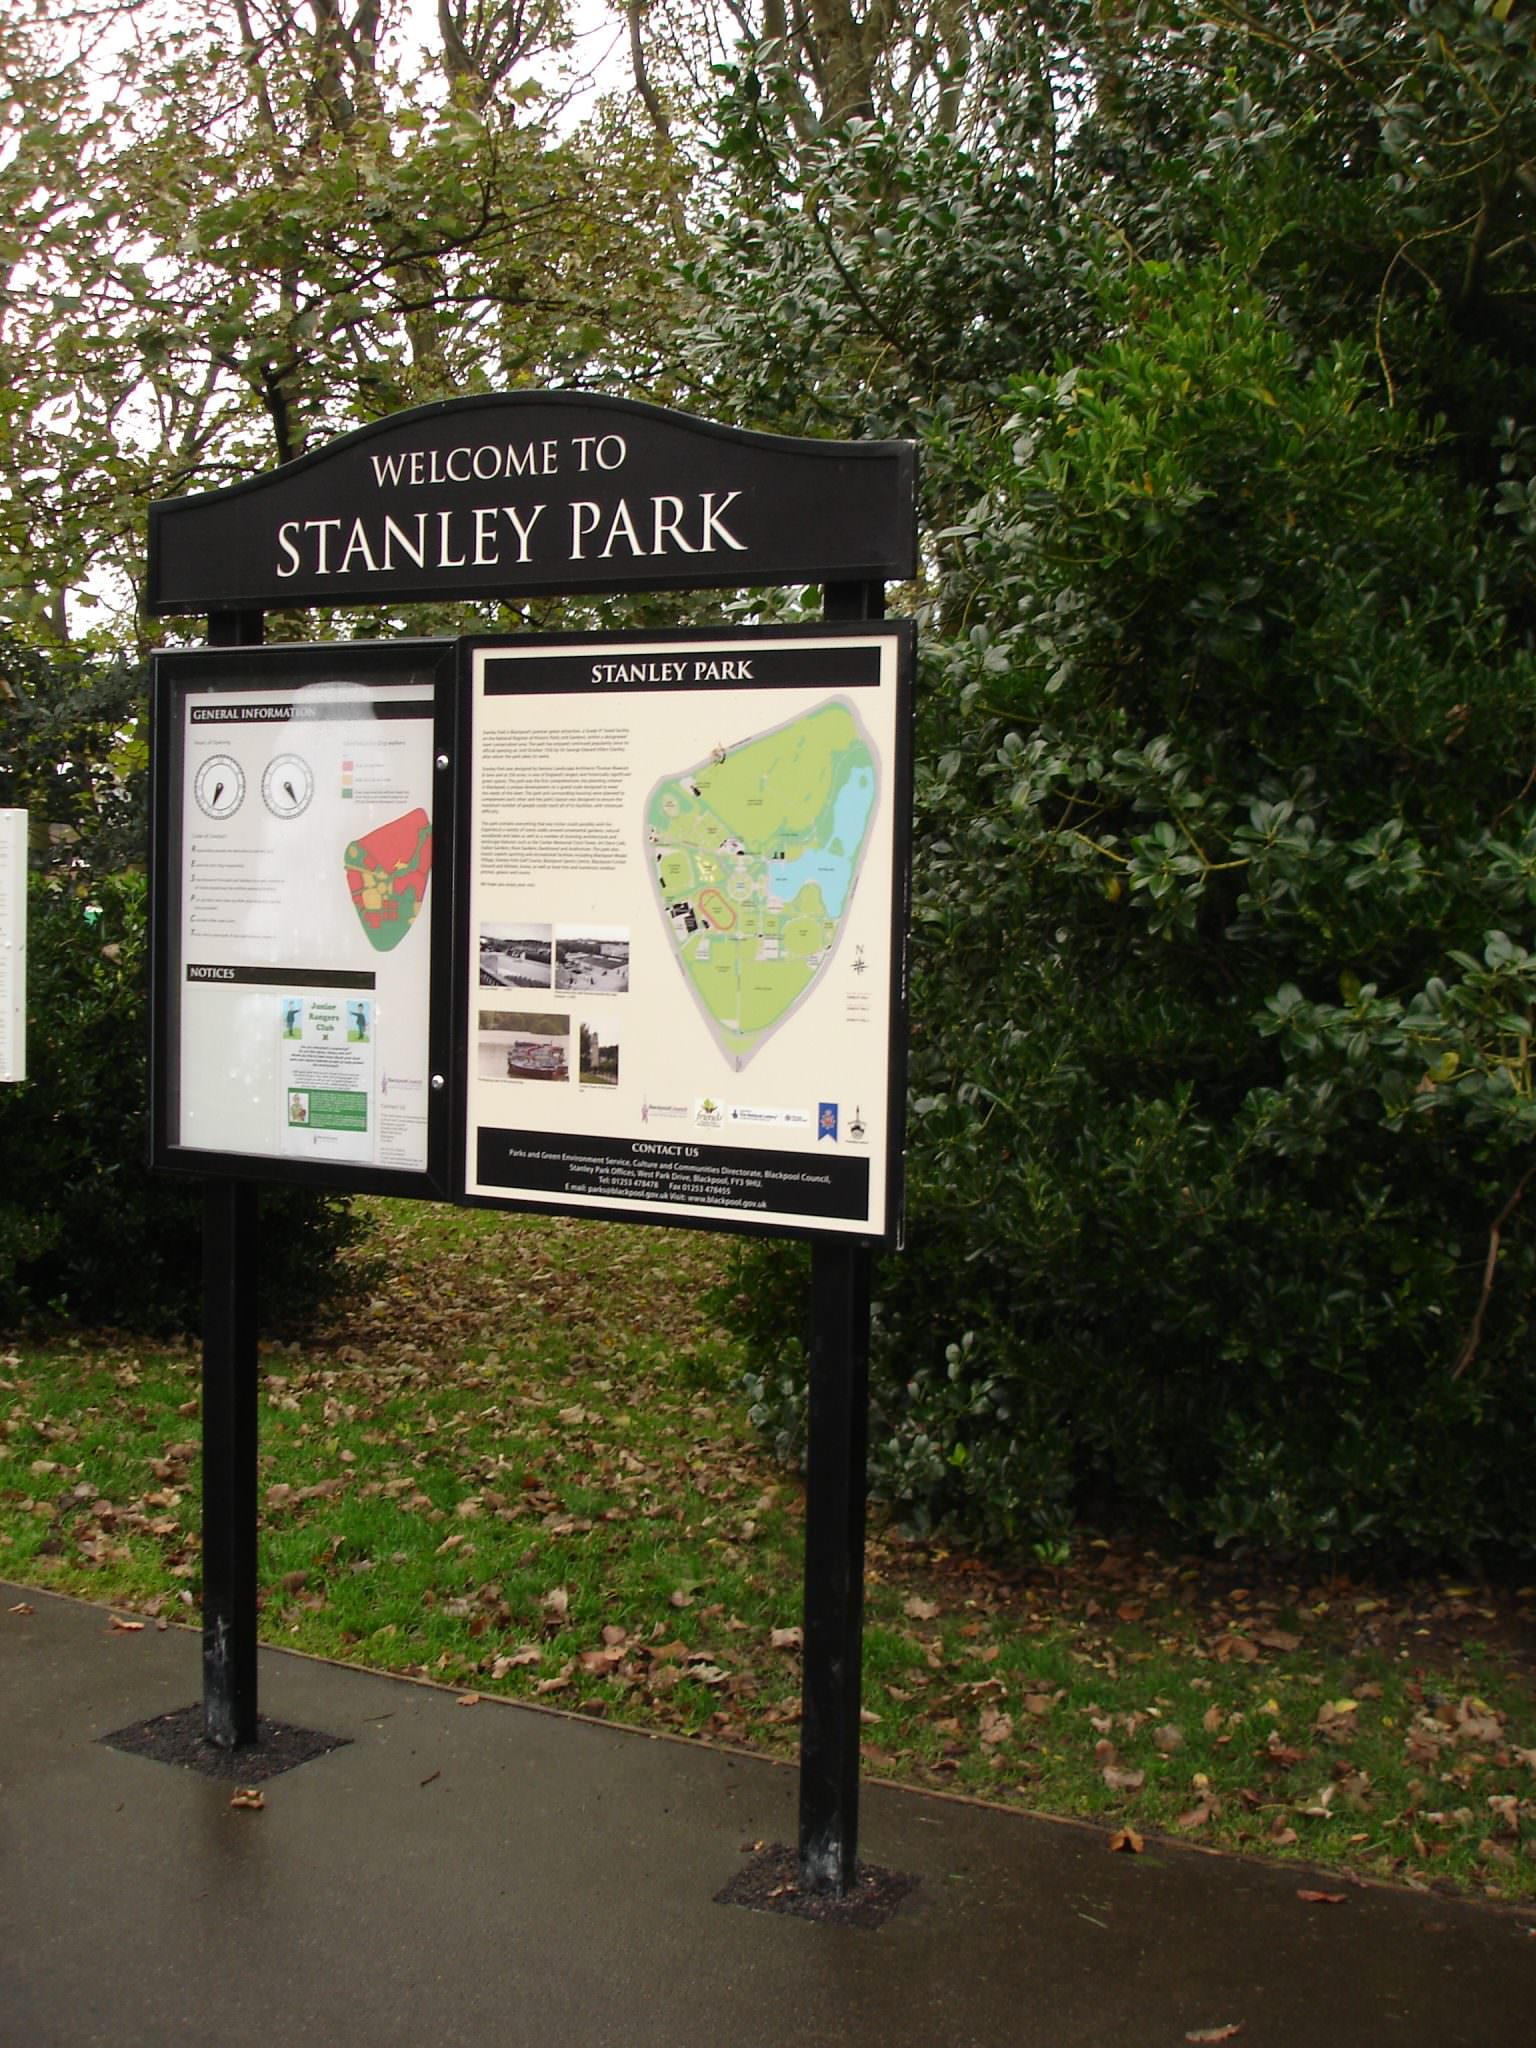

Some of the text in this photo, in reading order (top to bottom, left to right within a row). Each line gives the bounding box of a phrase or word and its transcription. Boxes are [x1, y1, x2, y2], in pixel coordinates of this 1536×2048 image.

[370, 435, 627, 488] WELCOME TO
[276, 490, 749, 578] STANLEY PARK
[591, 660, 755, 684] STANLEY PARK
[193, 709, 239, 720] GENERAL
[190, 967, 235, 979] NOTICES
[631, 1143, 699, 1157] CONTACT US
[509, 1148, 526, 1157] Parks
[541, 1151, 561, 1160] Green
[659, 1162, 673, 1170] and
[764, 1169, 800, 1181] Blackpool
[569, 1163, 594, 1174] Stanley
[595, 1165, 609, 1174] Park
[637, 1169, 654, 1178] West
[655, 1171, 670, 1179] Park
[669, 1182, 681, 1191] Fax
